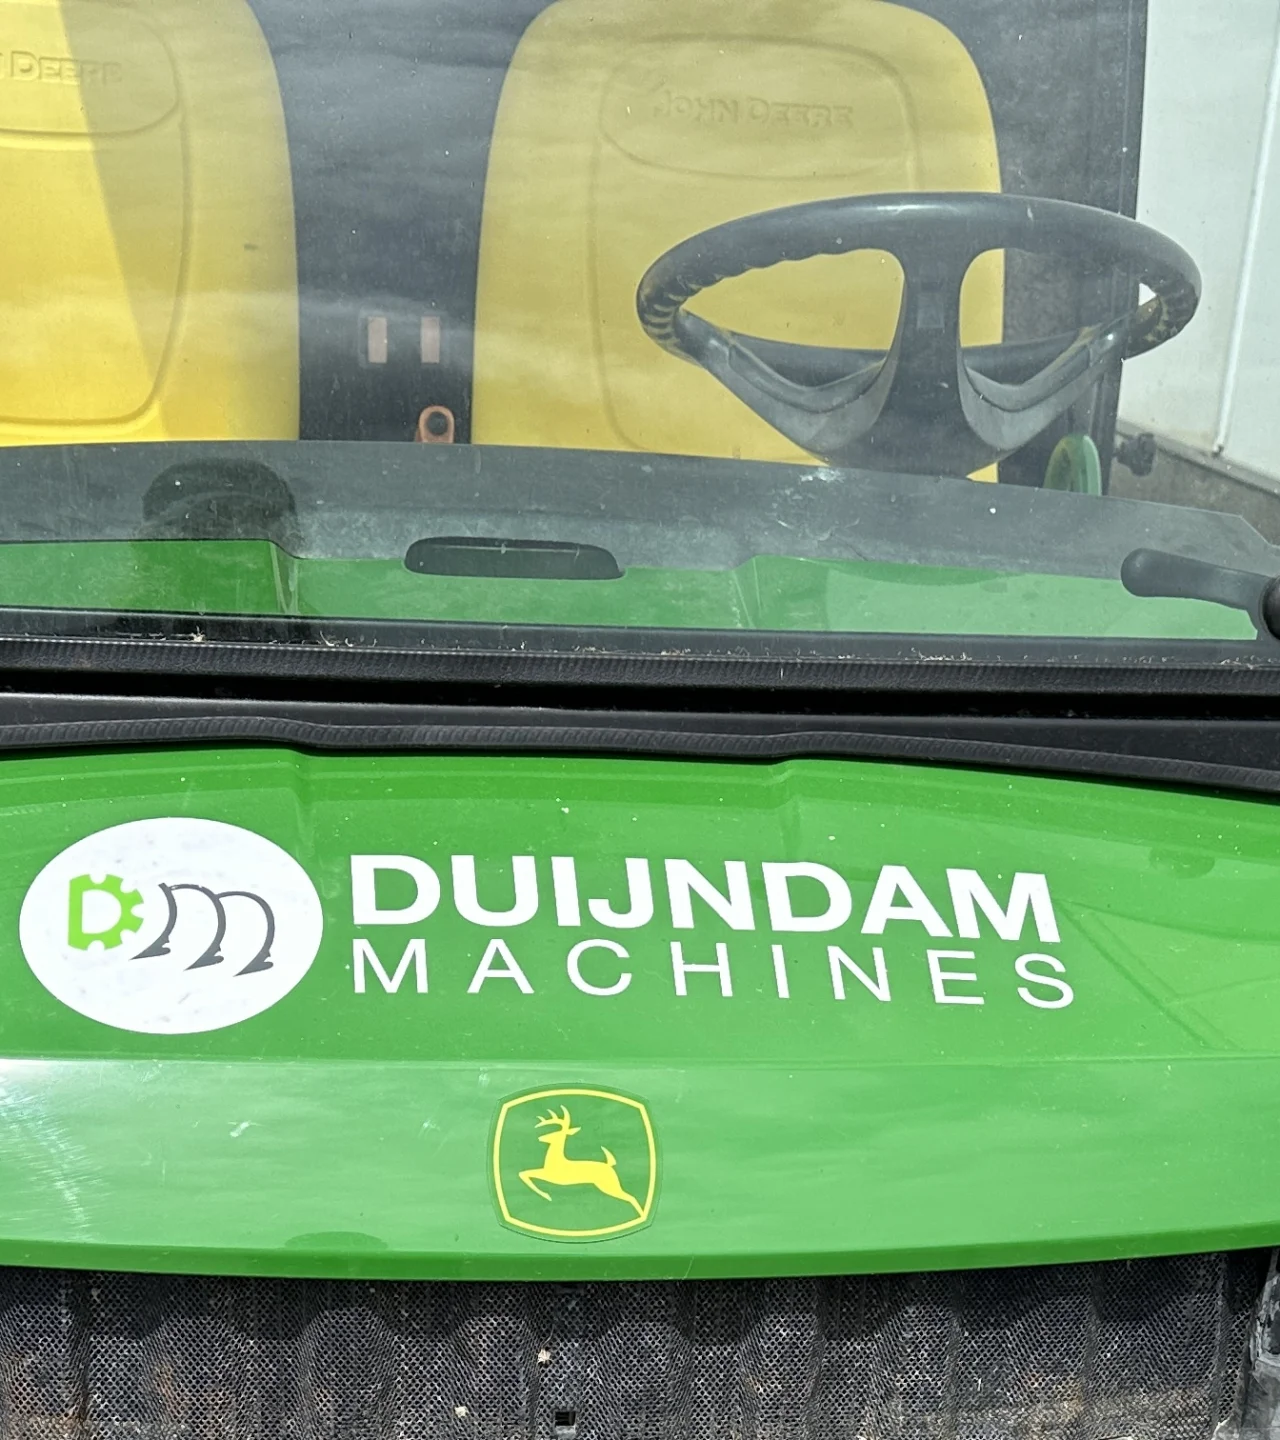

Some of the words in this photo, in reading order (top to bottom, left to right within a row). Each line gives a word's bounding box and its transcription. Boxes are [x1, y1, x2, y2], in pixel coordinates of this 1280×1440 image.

[10, 51, 122, 86] DEERE
[653, 90, 739, 124] JOHN
[747, 97, 853, 130] DEERE
[351, 854, 1061, 943] DUIJNDAM
[353, 938, 1074, 1010] MACHINES
